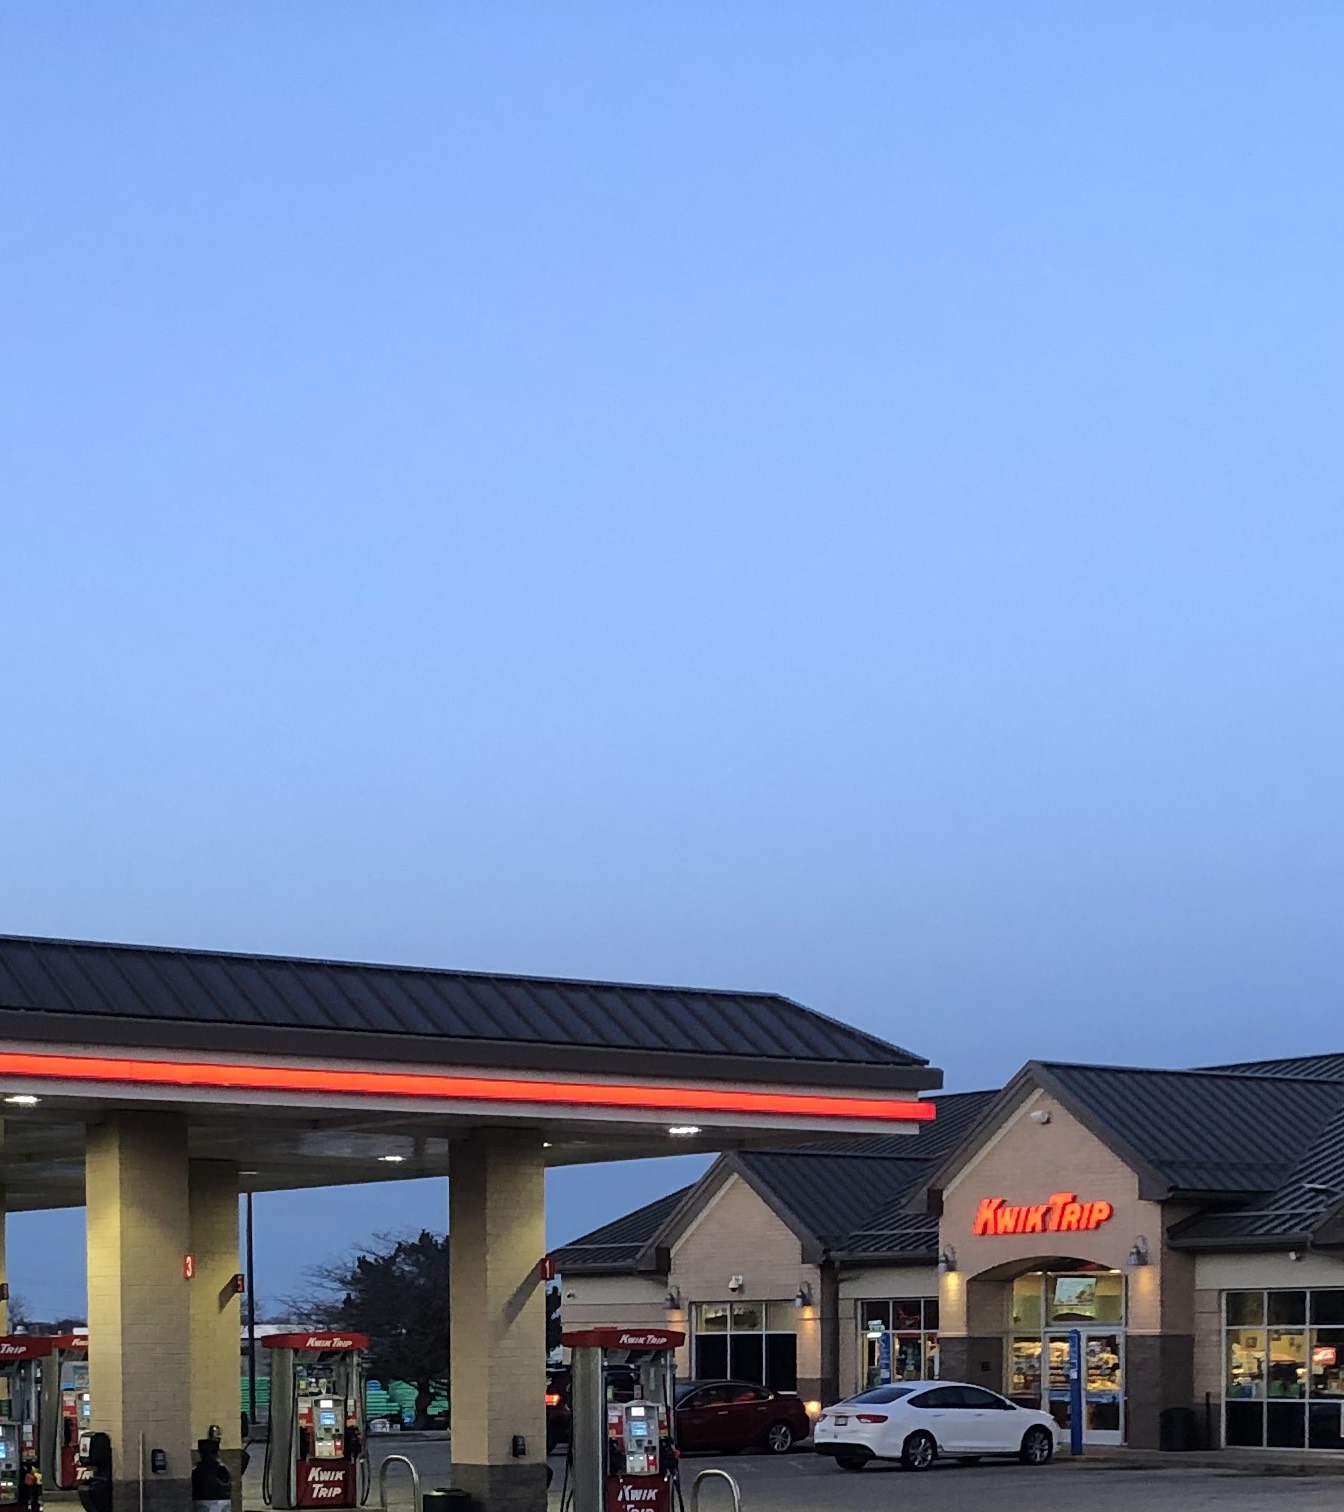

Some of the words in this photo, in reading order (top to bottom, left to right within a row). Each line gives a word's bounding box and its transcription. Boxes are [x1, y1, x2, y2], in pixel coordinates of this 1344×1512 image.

[973, 1198, 1050, 1235] KWIK
[1049, 1192, 1113, 1231] TRIP
[186, 1256, 192, 1277] 3
[545, 1260, 550, 1279] 1
[306, 1337, 331, 1347] KWIK
[332, 1337, 353, 1348] TRIP
[619, 1334, 646, 1344] KWIK
[646, 1335, 667, 1345] TRIP
[0, 1343, 27, 1354] TRIP
[308, 1466, 346, 1482] KWIK
[312, 1483, 342, 1499] TRIP
[617, 1484, 658, 1501] KWIK
